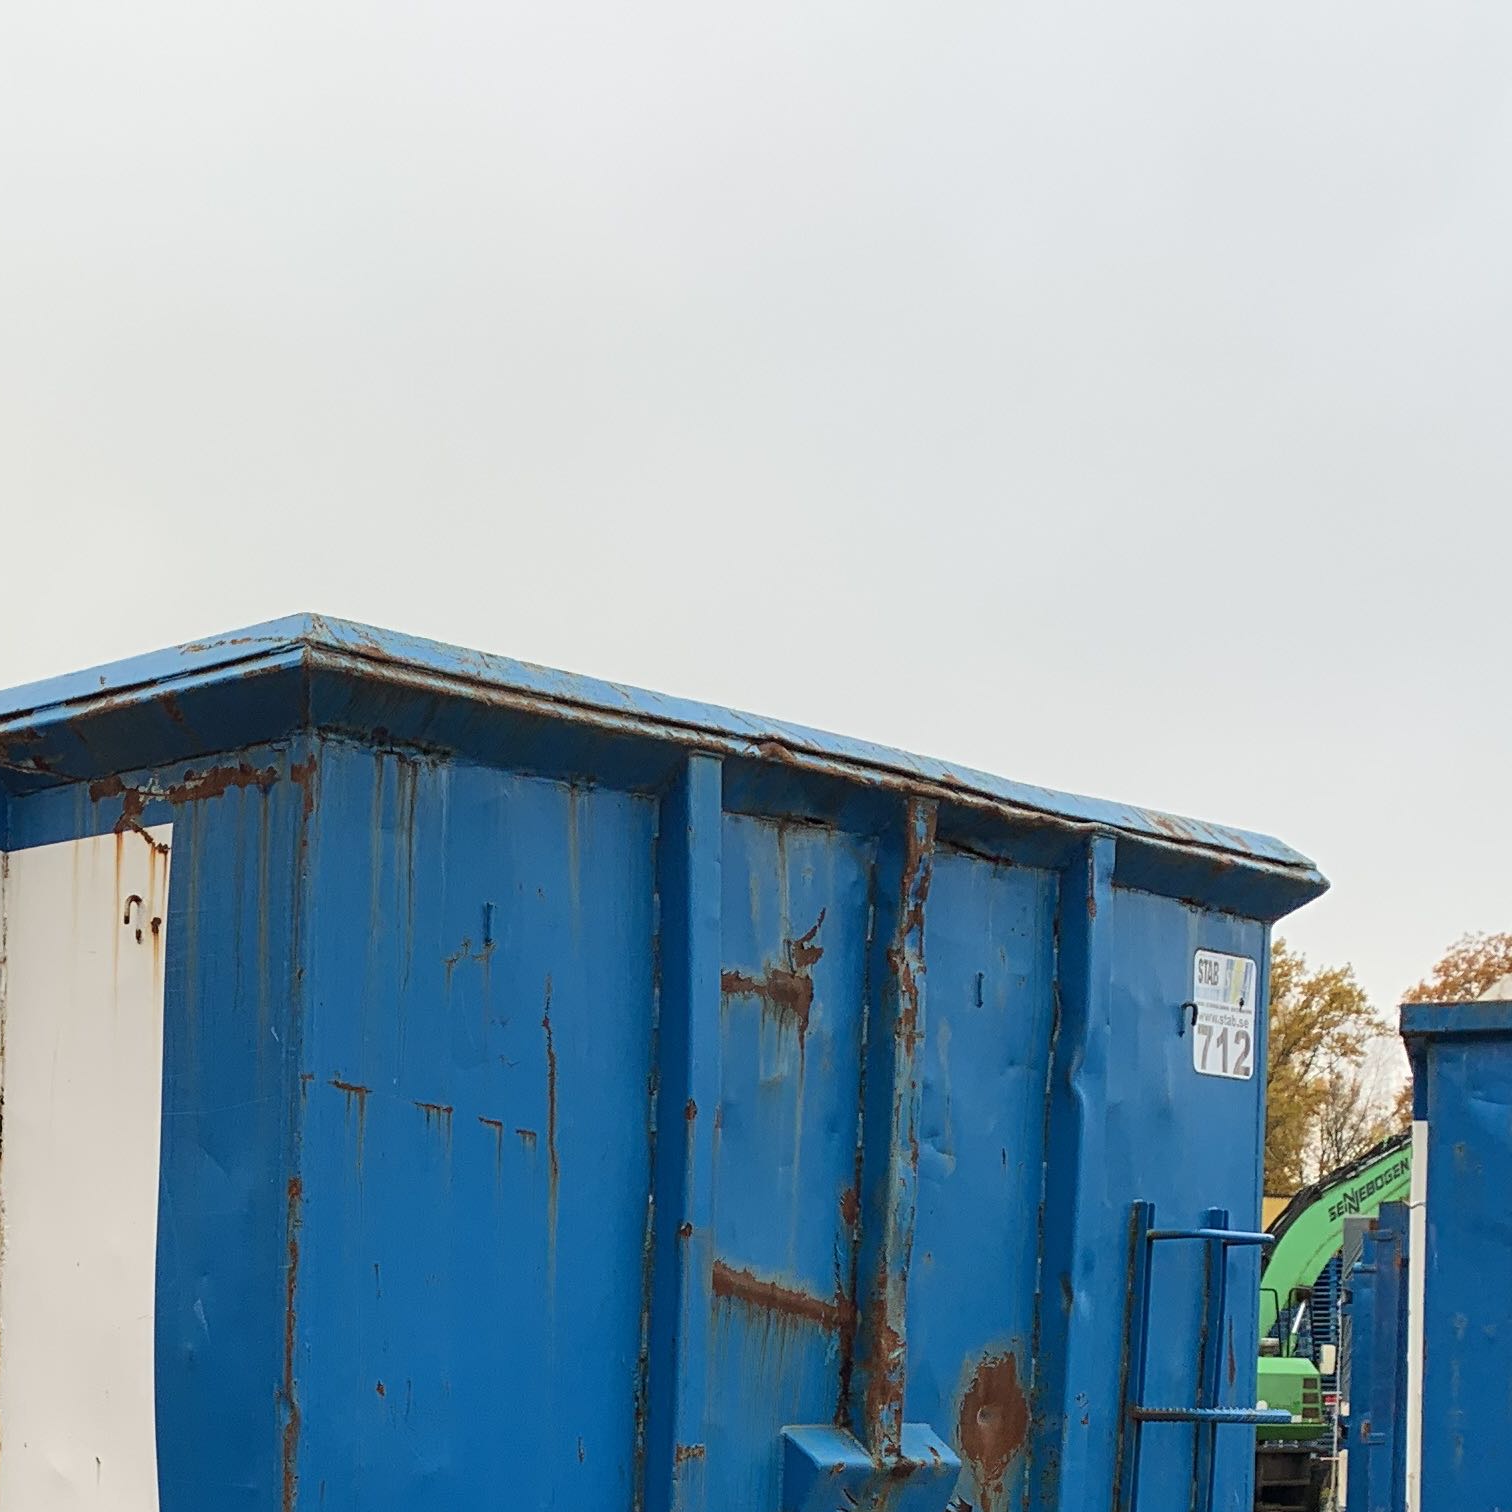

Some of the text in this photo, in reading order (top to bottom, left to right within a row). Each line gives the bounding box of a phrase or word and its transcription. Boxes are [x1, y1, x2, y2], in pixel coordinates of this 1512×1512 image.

[1198, 958, 1219, 986] STAB
[1198, 1012, 1250, 1029] www.stab.se
[1197, 1023, 1251, 1077] 712
[1327, 1158, 1410, 1223] SENNEBOGEN
